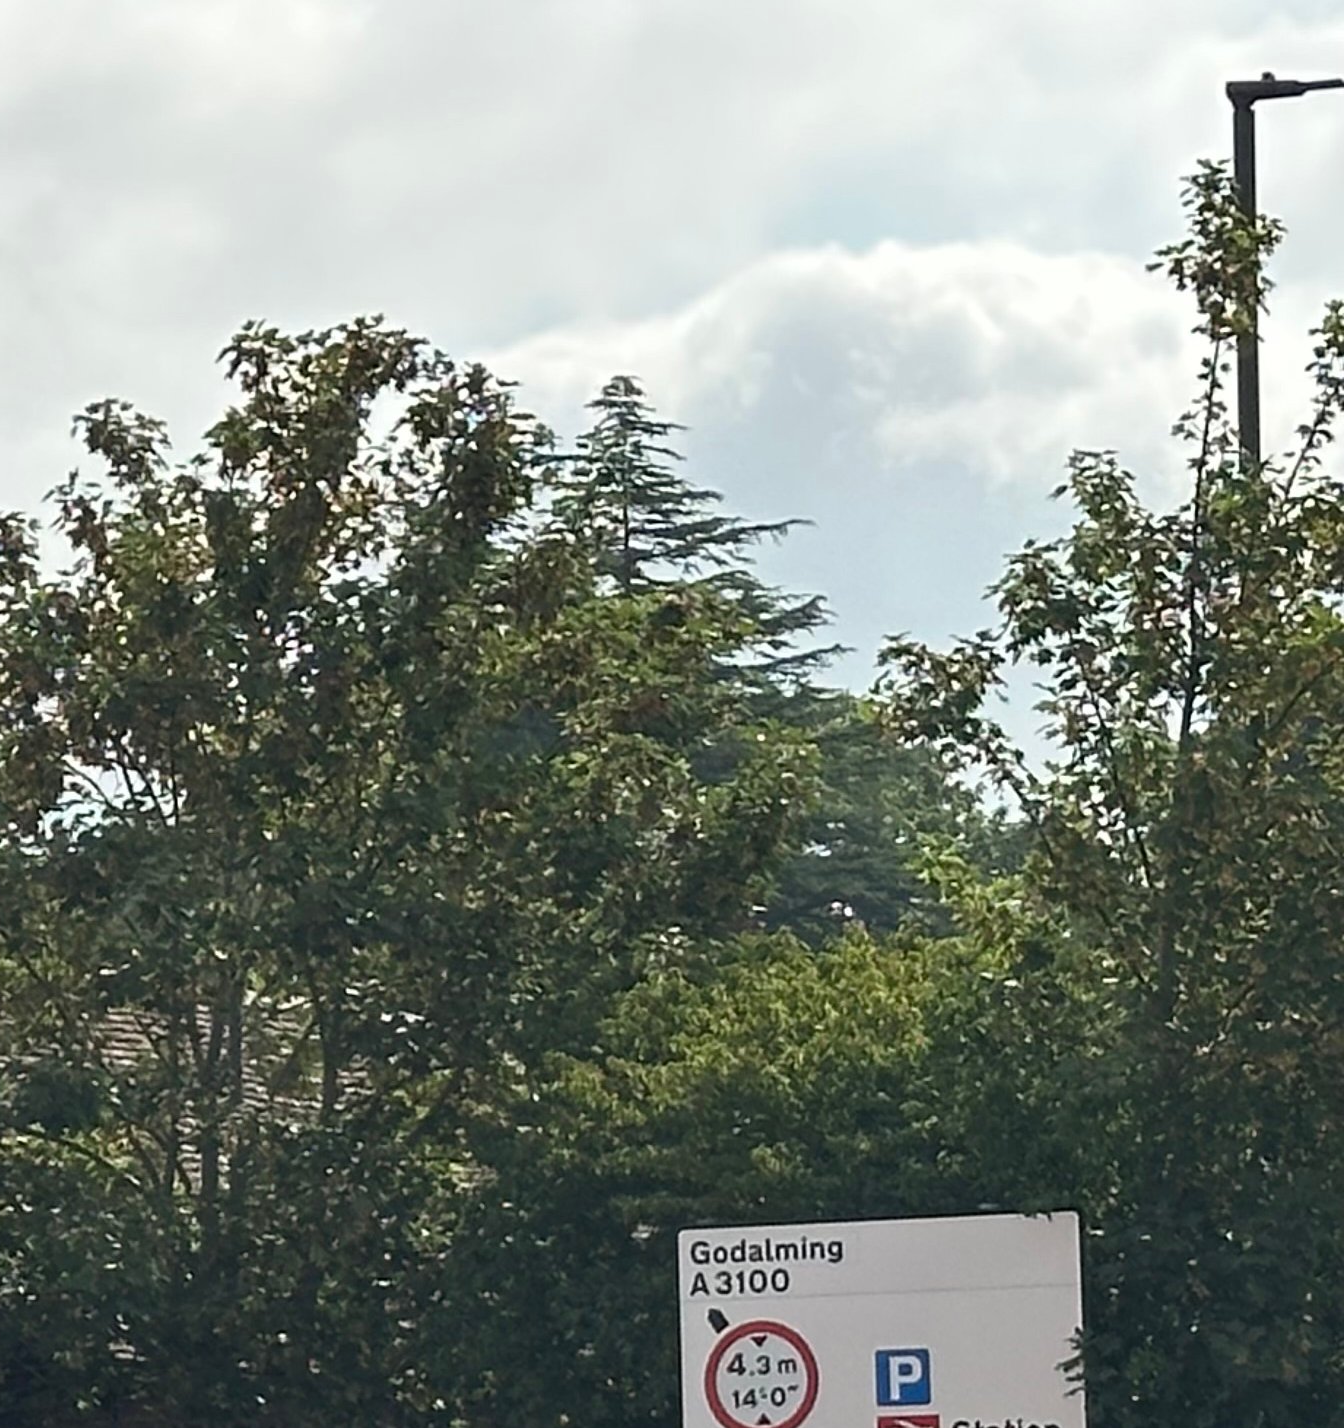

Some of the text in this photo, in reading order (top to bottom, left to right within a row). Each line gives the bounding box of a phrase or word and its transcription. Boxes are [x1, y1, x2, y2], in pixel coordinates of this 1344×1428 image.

[689, 1234, 844, 1266] Godalming
[689, 1267, 790, 1296] A3100
[726, 1352, 798, 1377] 4.3 m
[887, 1354, 924, 1401] P
